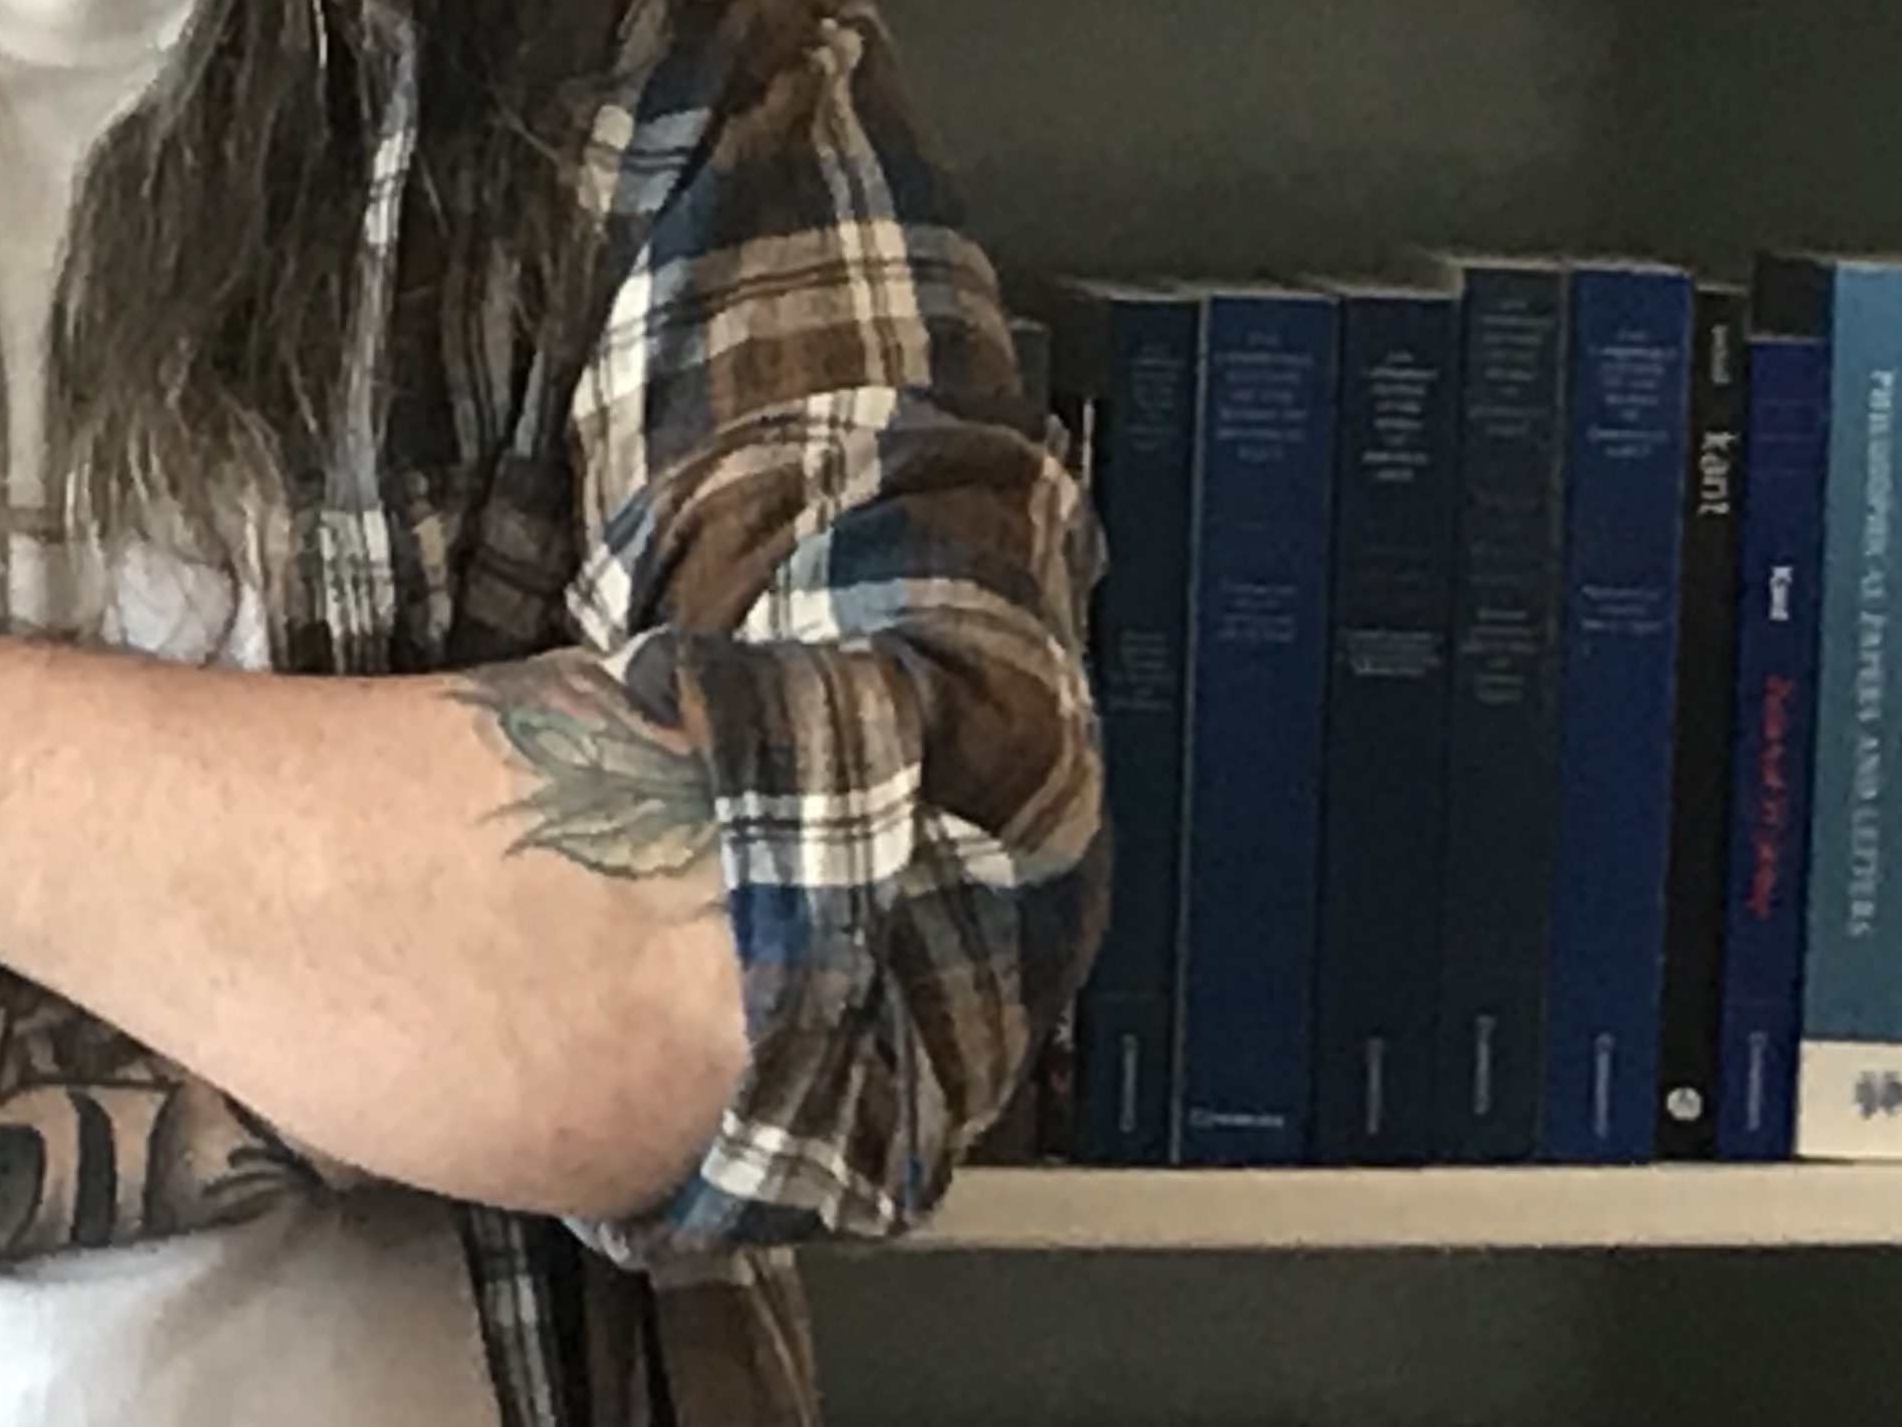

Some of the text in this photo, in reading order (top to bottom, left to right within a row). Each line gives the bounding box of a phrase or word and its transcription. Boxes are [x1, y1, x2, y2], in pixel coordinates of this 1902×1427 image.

[1855, 610, 1890, 723] PAPERS
[1854, 737, 1884, 802] AND
[1847, 807, 1881, 938] LETTERS
